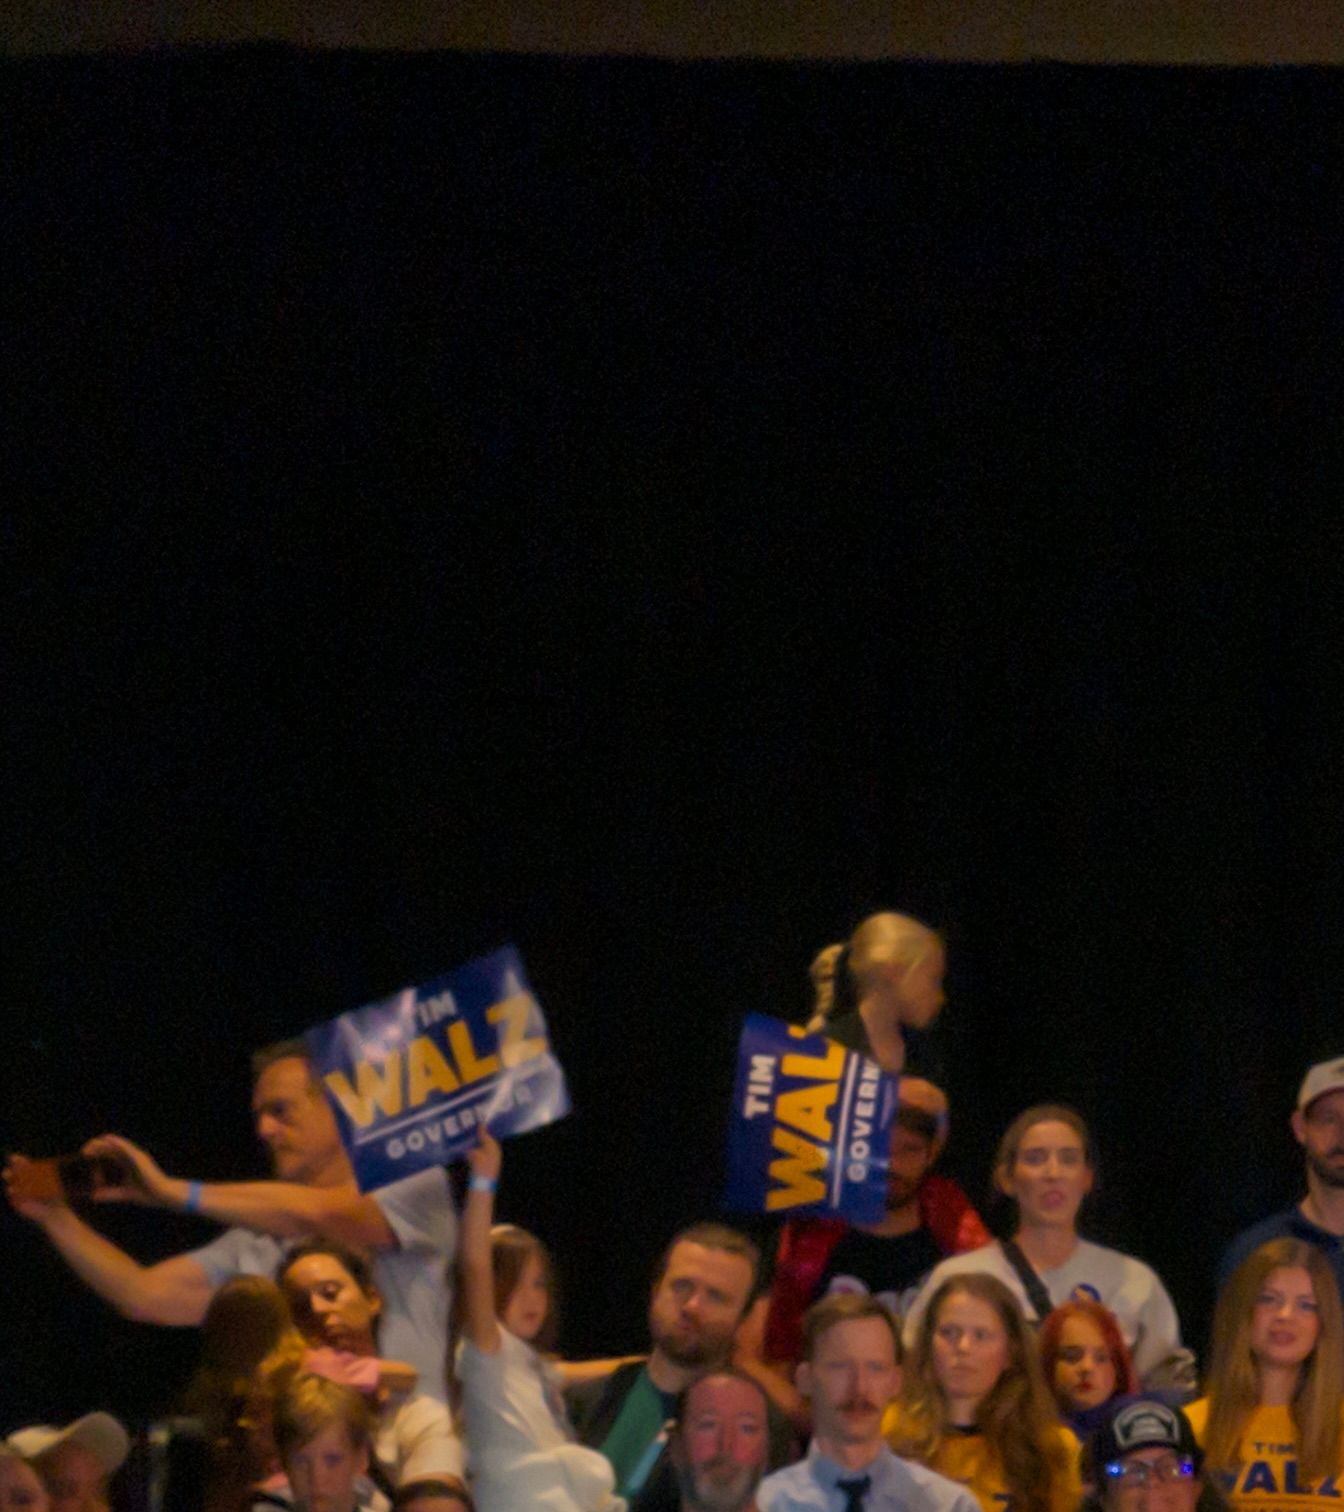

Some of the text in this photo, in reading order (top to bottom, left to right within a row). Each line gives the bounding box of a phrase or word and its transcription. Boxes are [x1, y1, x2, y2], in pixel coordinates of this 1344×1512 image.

[323, 990, 547, 1128] WALZ
[742, 1053, 776, 1119] TIM
[765, 1023, 847, 1211] WAL
[847, 1059, 881, 1182] GOVERN
[1222, 1460, 1341, 1497] ALZ
